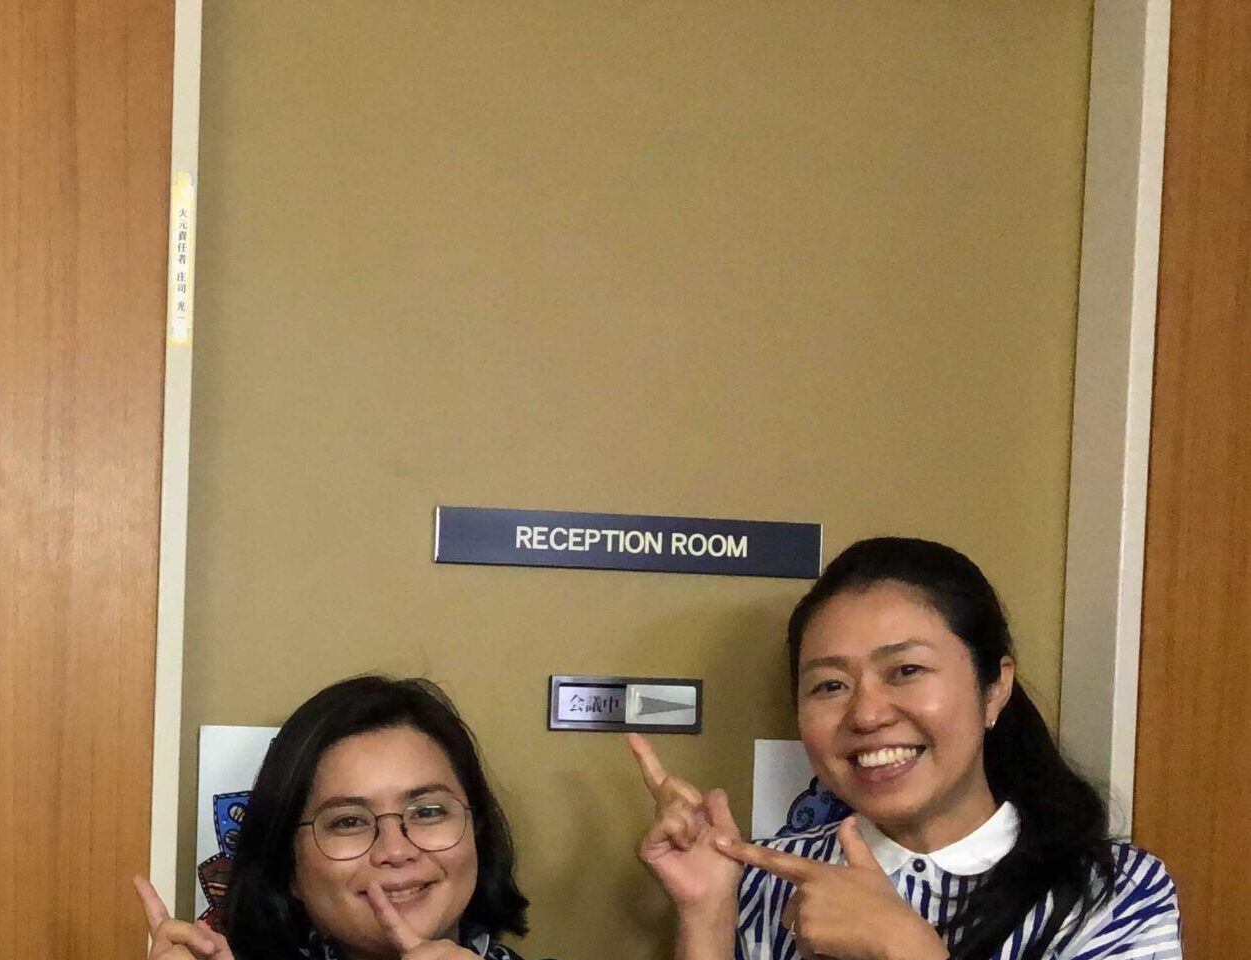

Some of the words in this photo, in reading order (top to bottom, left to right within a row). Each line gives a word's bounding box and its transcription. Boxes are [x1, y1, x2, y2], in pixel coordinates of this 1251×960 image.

[515, 525, 663, 554] RECEPTION
[671, 533, 748, 557] ROOM
[569, 694, 620, 713] 会議中
